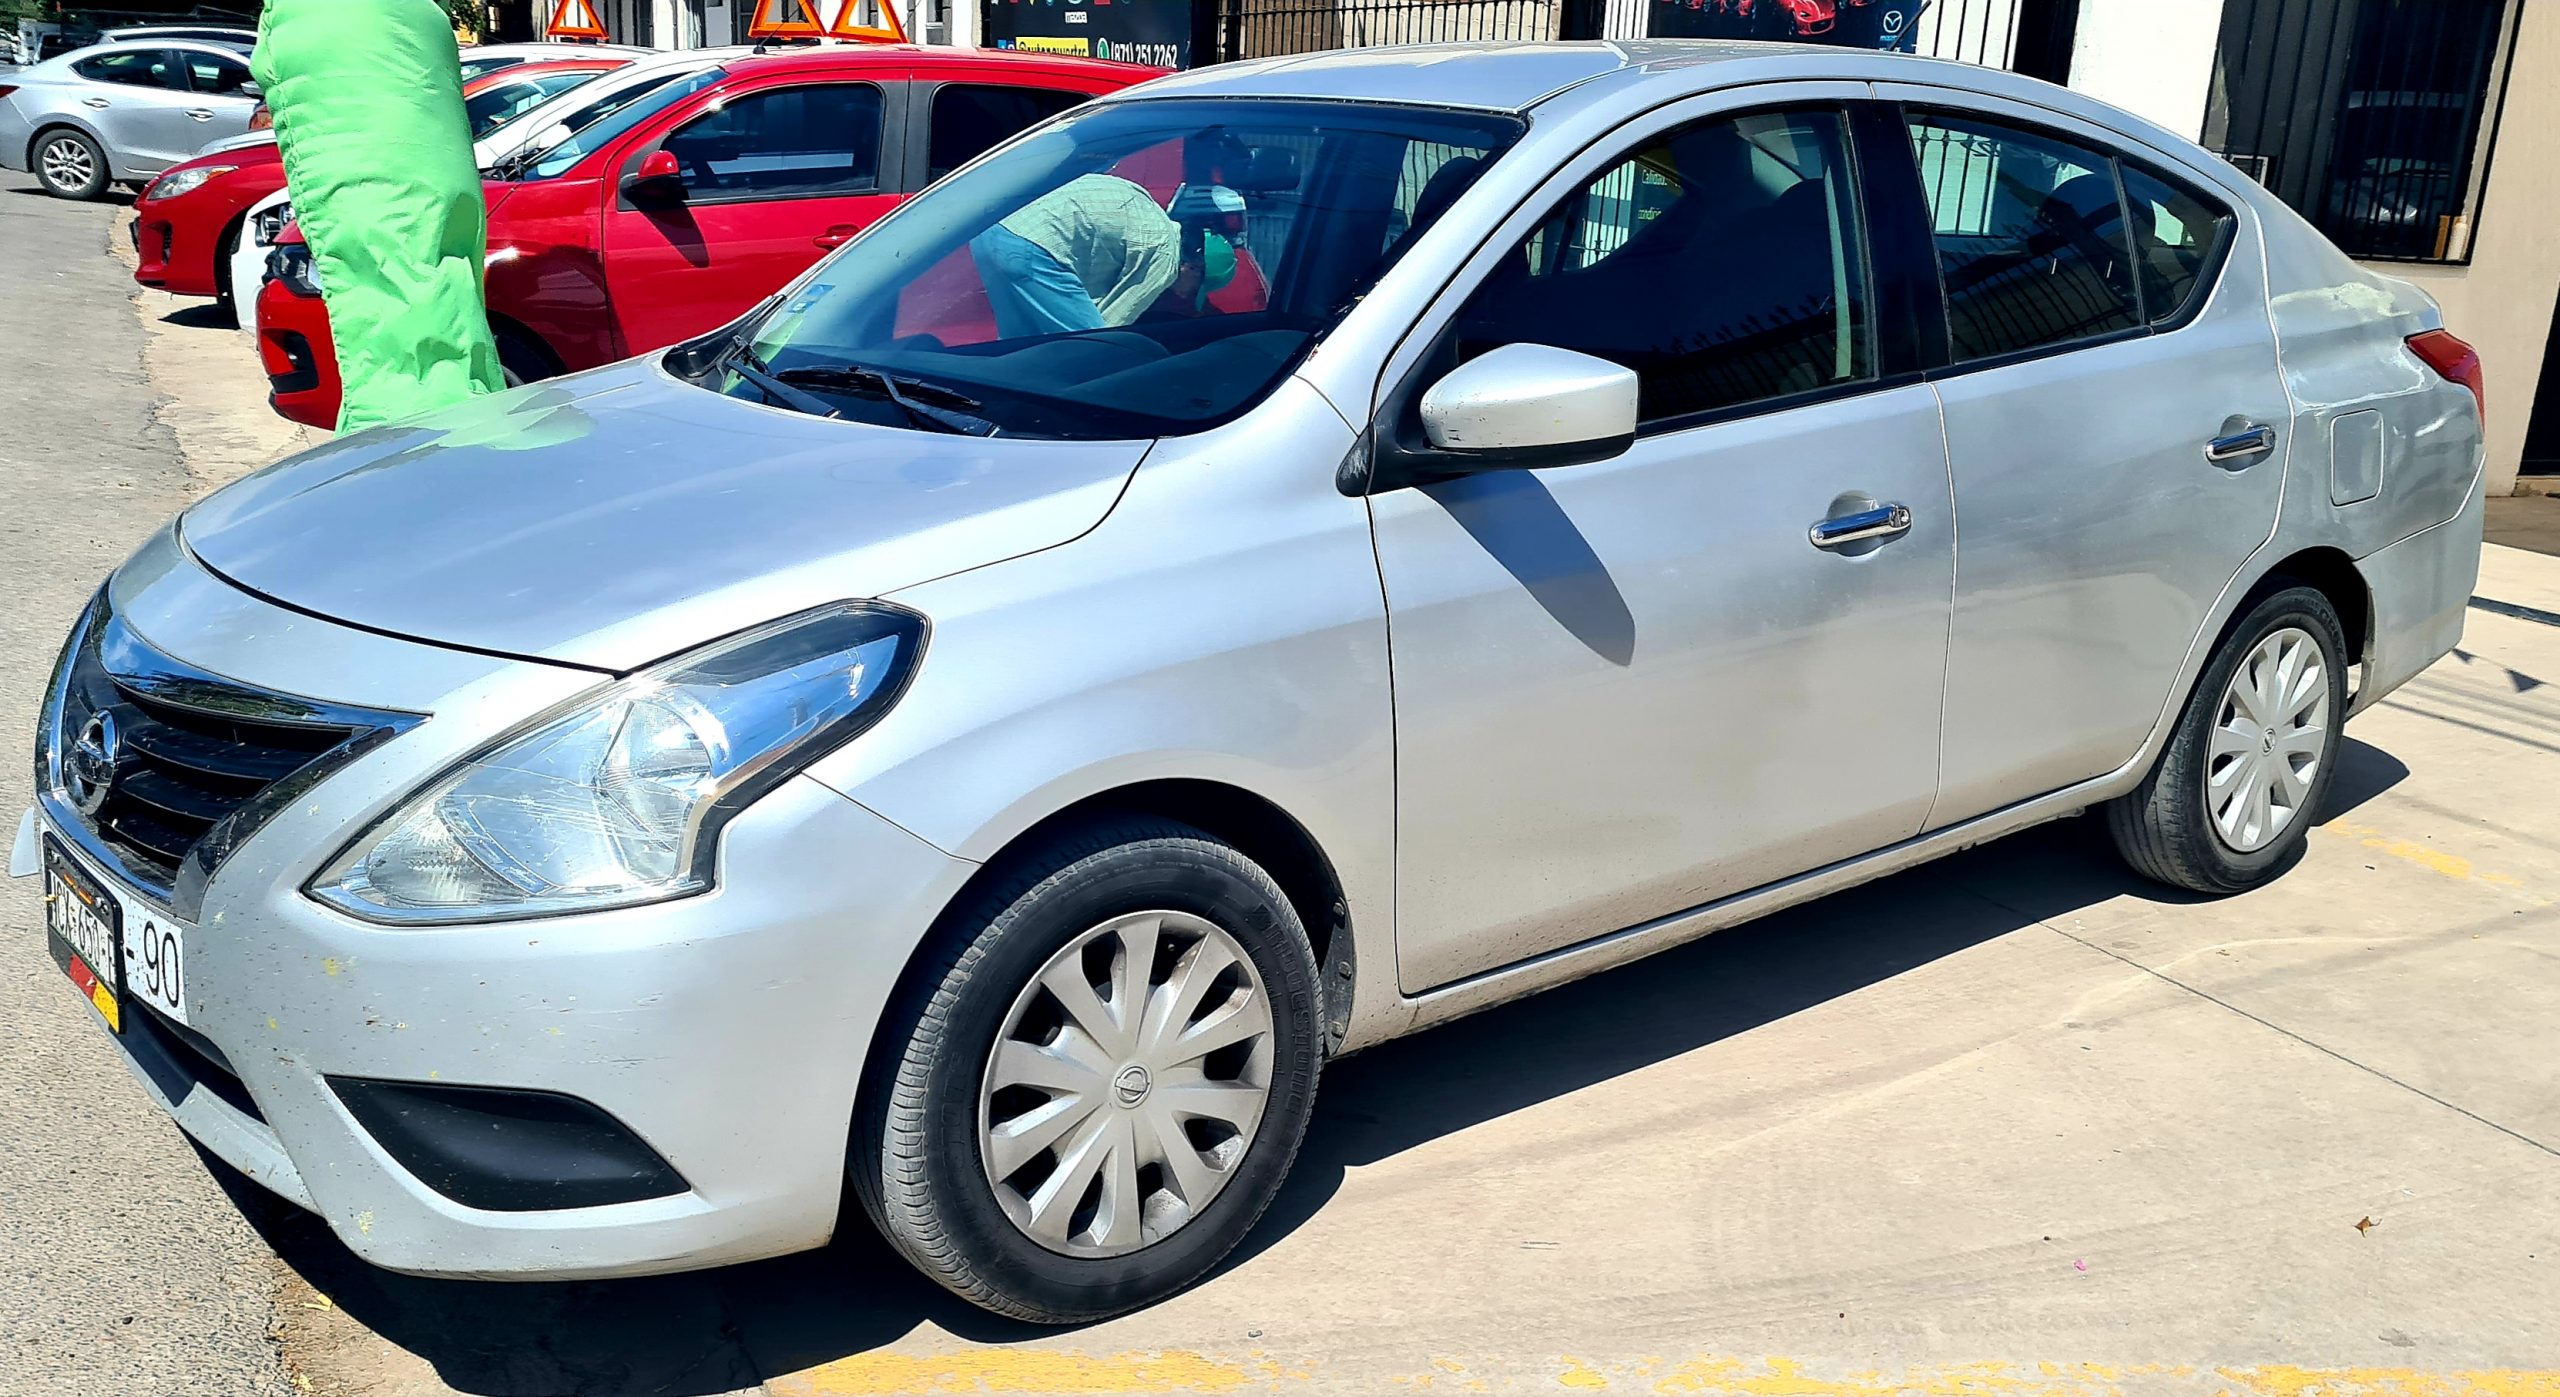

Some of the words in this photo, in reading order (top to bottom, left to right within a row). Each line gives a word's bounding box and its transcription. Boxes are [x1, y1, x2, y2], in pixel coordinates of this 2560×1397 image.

[1111, 41, 1134, 62] (871)
[1135, 43, 1152, 65] 251
[1153, 44, 1178, 68] 2262
